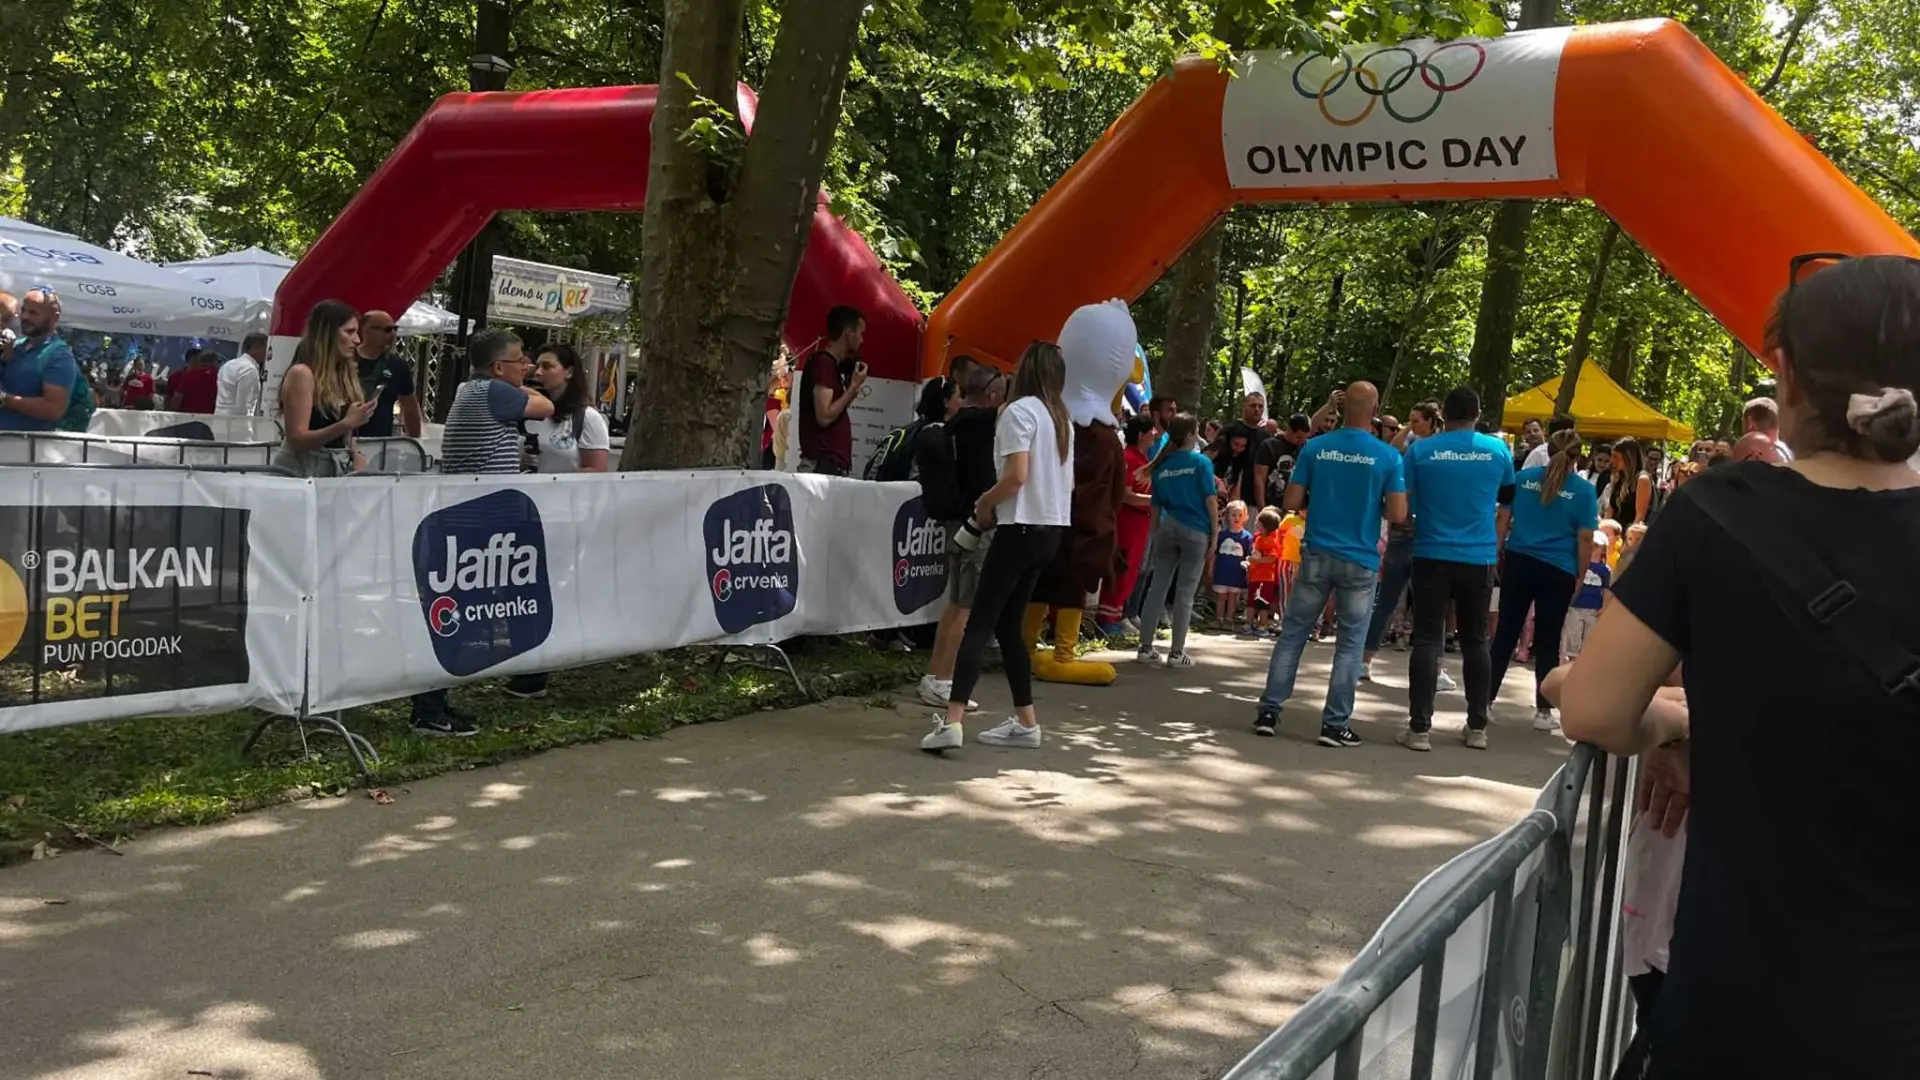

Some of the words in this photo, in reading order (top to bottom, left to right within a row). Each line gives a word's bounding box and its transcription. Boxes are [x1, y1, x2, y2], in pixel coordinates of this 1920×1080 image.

[1246, 140, 1427, 174] OLYMPIC
[1442, 135, 1527, 168] DAY
[2, 243, 104, 265] rosa
[78, 283, 117, 297] rosa
[190, 296, 225, 311] rosa
[498, 278, 534, 299] Idemo
[535, 290, 544, 301] u
[712, 518, 792, 567] Jaffa
[897, 517, 948, 557] Jaffa
[46, 546, 214, 593] BALKAN
[428, 532, 539, 593] Jaffa
[909, 562, 945, 578] crvenka
[733, 571, 789, 590] crvenka
[44, 594, 129, 641] BET
[464, 595, 539, 622] crvenka
[44, 642, 86, 664] PUN
[91, 635, 183, 659] POGODAK
